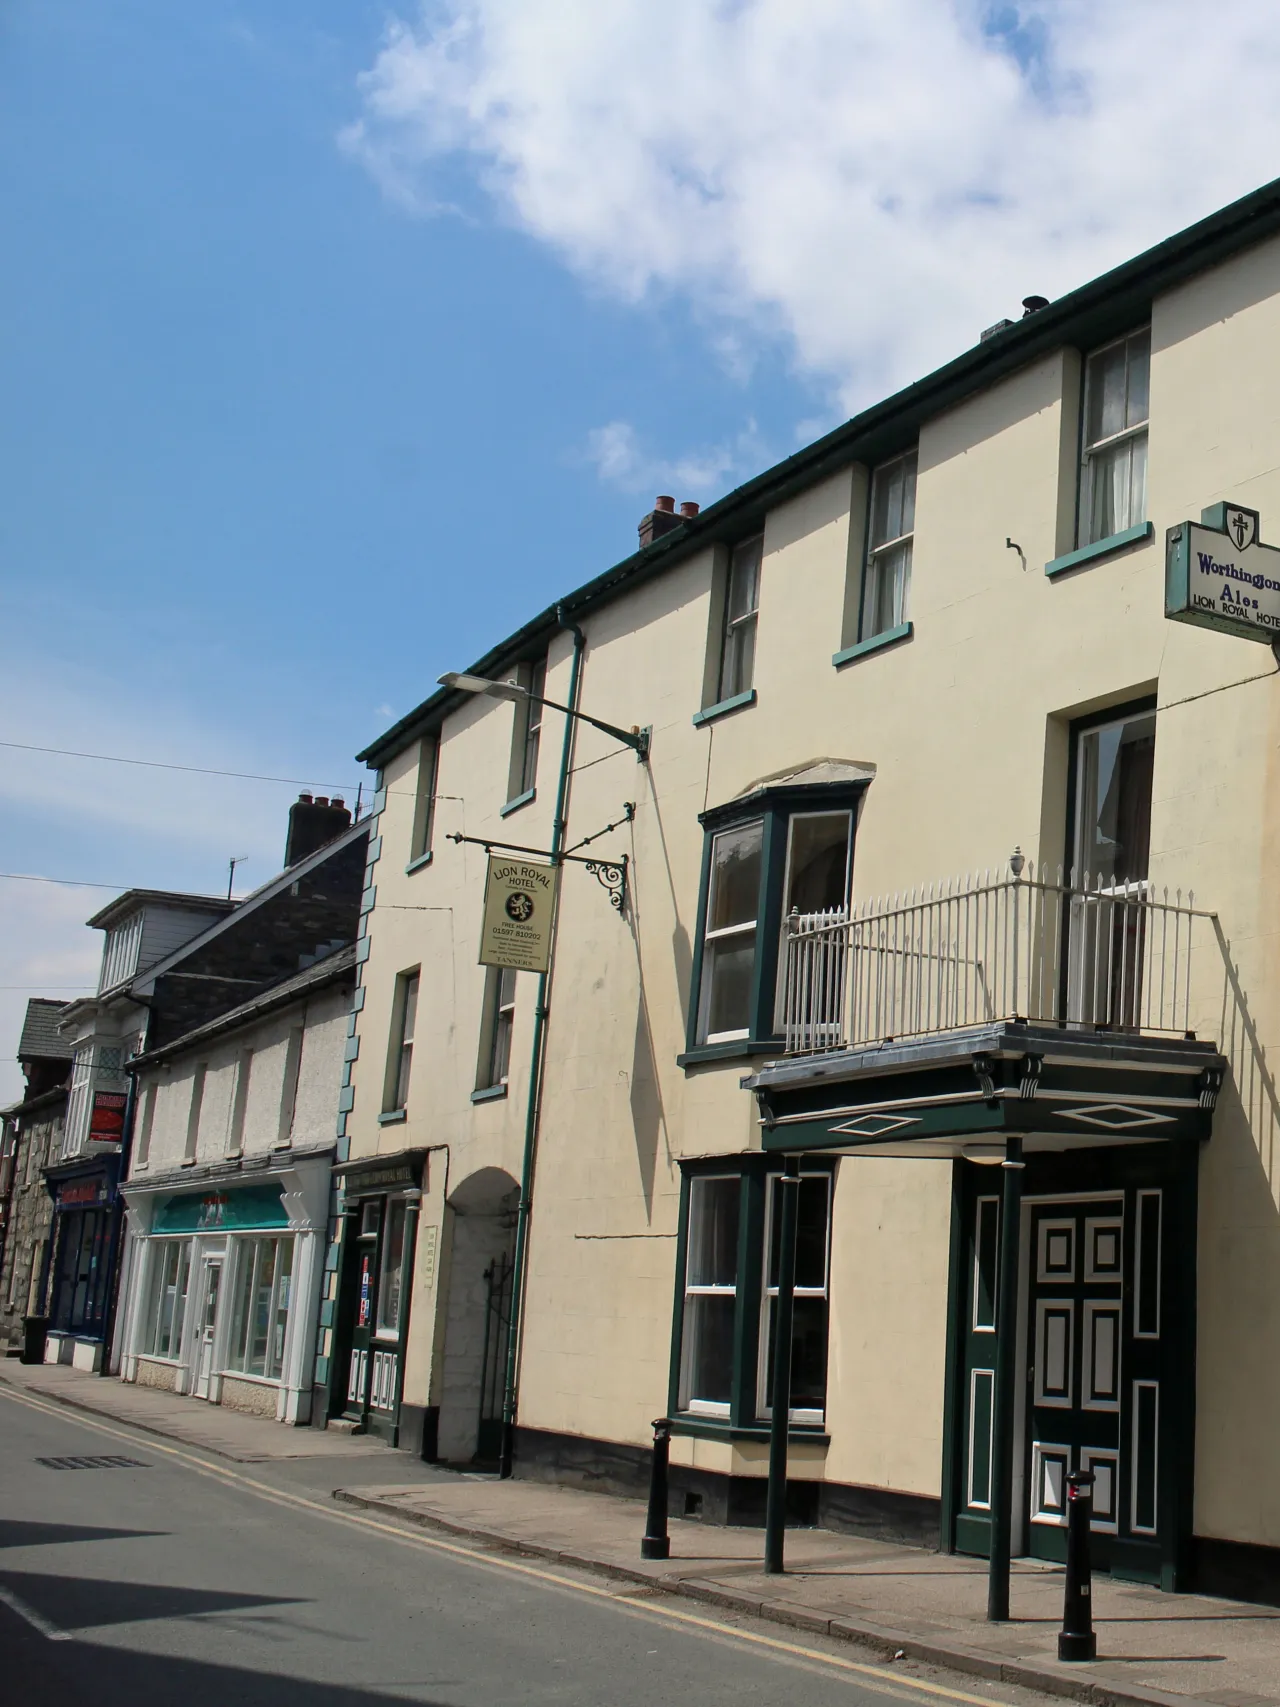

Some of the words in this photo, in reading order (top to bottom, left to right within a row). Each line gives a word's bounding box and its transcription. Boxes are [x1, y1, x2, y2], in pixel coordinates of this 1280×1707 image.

[1197, 552, 1280, 592] Worthington
[1194, 594, 1216, 610] LION
[1222, 602, 1250, 619] ROYAL
[1220, 584, 1258, 609] Ales
[494, 867, 518, 880] LION
[521, 867, 551, 889] ROYAL
[509, 878, 535, 888] HOTEL
[493, 927, 514, 936] 01597
[516, 930, 541, 940] 810202
[497, 957, 533, 966] TANNERS
